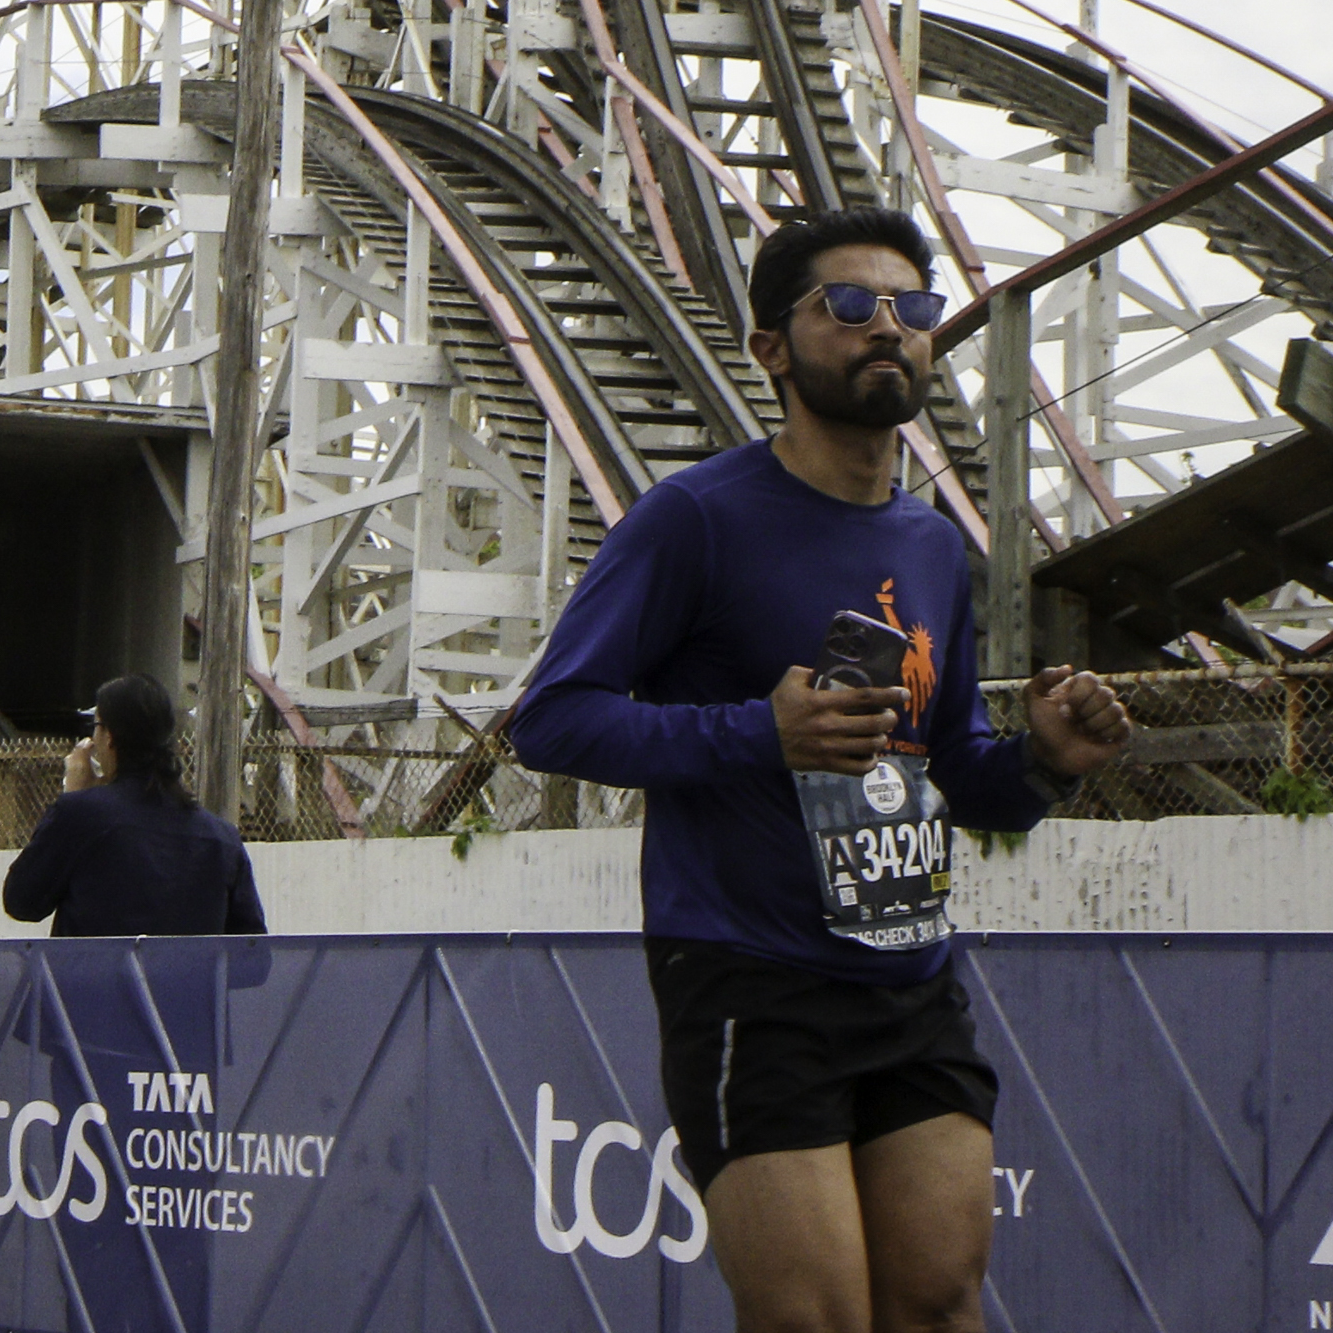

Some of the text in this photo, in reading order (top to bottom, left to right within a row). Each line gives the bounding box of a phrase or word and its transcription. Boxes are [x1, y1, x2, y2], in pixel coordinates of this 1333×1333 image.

[866, 781, 903, 794] BROOKLYN
[878, 792, 895, 803] HALF
[855, 819, 946, 882] 34204
[875, 925, 916, 946] CHECK
[127, 1071, 214, 1114] TATA
[126, 1127, 335, 1178] CONSULTANCY
[535, 1082, 709, 1264] tcs
[125, 1185, 254, 1233] SERVICES
